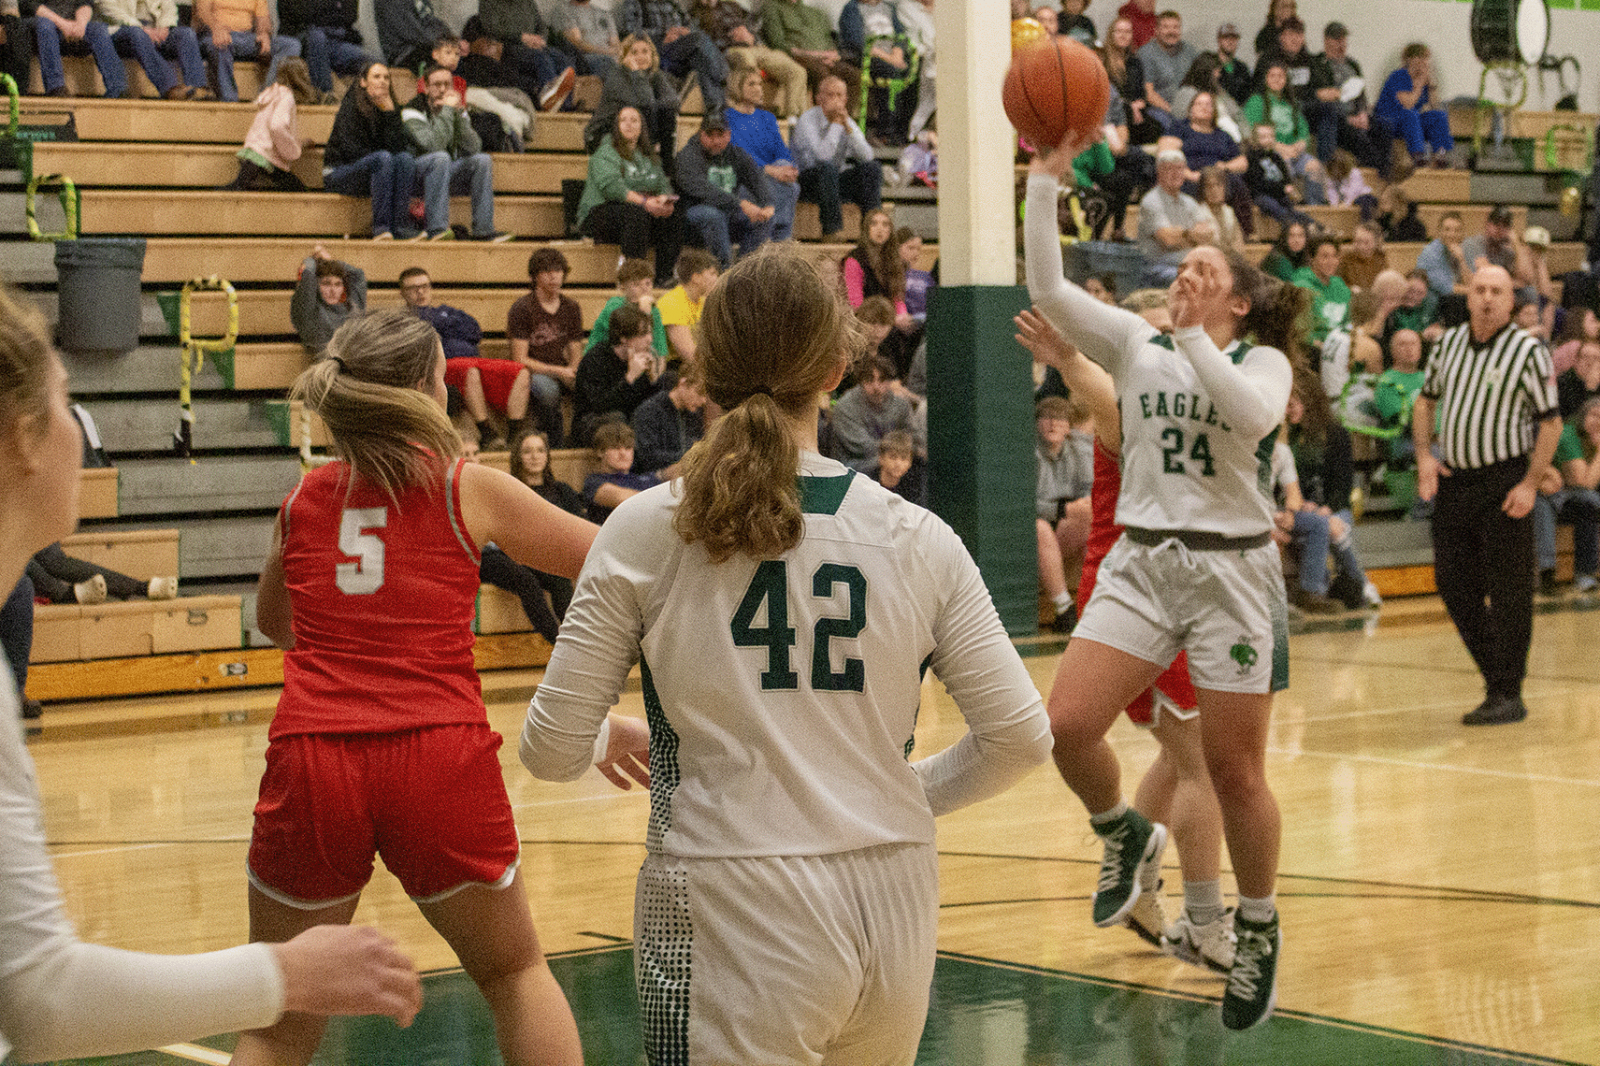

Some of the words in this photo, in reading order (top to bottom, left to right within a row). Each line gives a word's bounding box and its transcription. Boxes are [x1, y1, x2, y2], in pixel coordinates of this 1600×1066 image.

[1139, 391, 1231, 432] EAGLE
[1161, 428, 1215, 476] 24
[335, 506, 388, 595] 5
[730, 560, 868, 692] 42
